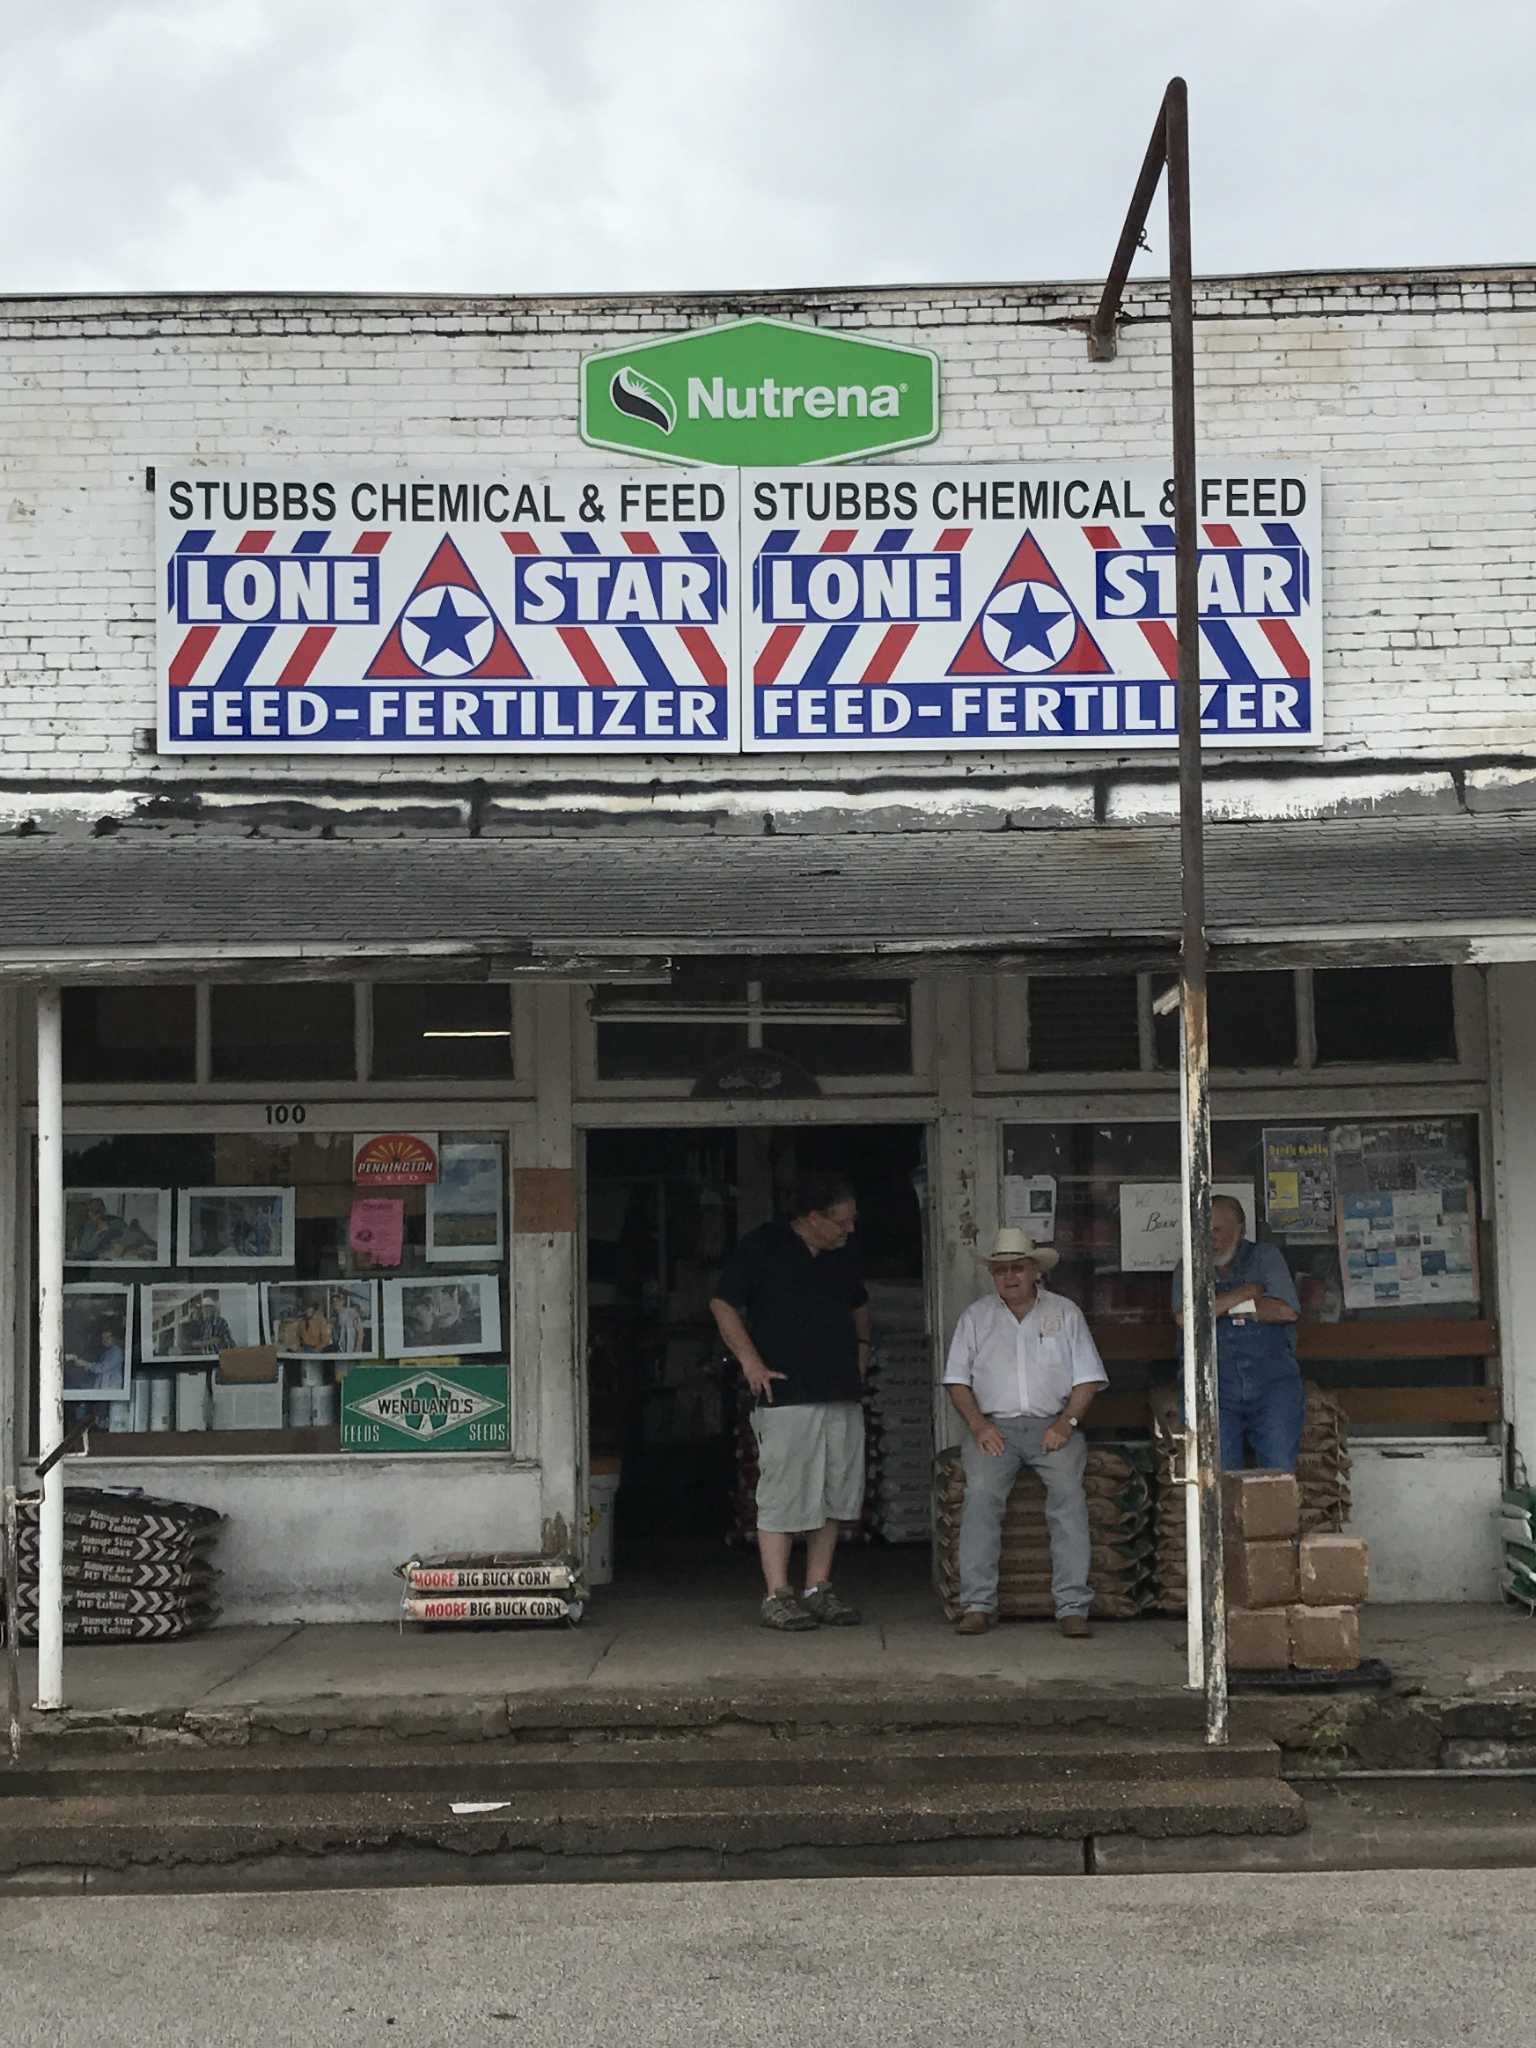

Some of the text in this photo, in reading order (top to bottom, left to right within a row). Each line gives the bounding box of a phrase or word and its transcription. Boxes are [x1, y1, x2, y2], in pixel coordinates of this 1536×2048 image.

[168, 481, 725, 524] STUBBS CHEMICAL & FEED
[753, 480, 918, 521] STUBBS
[932, 479, 1146, 520] CHEMICAL
[1201, 478, 1307, 517] FEED
[186, 558, 712, 623] LONE STAR
[772, 553, 1296, 621] LONE STAR
[177, 689, 718, 737] FEED-FERTILIZER
[265, 1105, 306, 1125] 100
[357, 1161, 434, 1174] PENNINGTON
[377, 1397, 474, 1415] WENDLAND'S
[344, 1423, 506, 1443] FEEDS SEEDS
[414, 1570, 551, 1588] MOORE BIG BUCK CORN
[425, 1601, 562, 1618] MOORE BIG BUCK CORN
